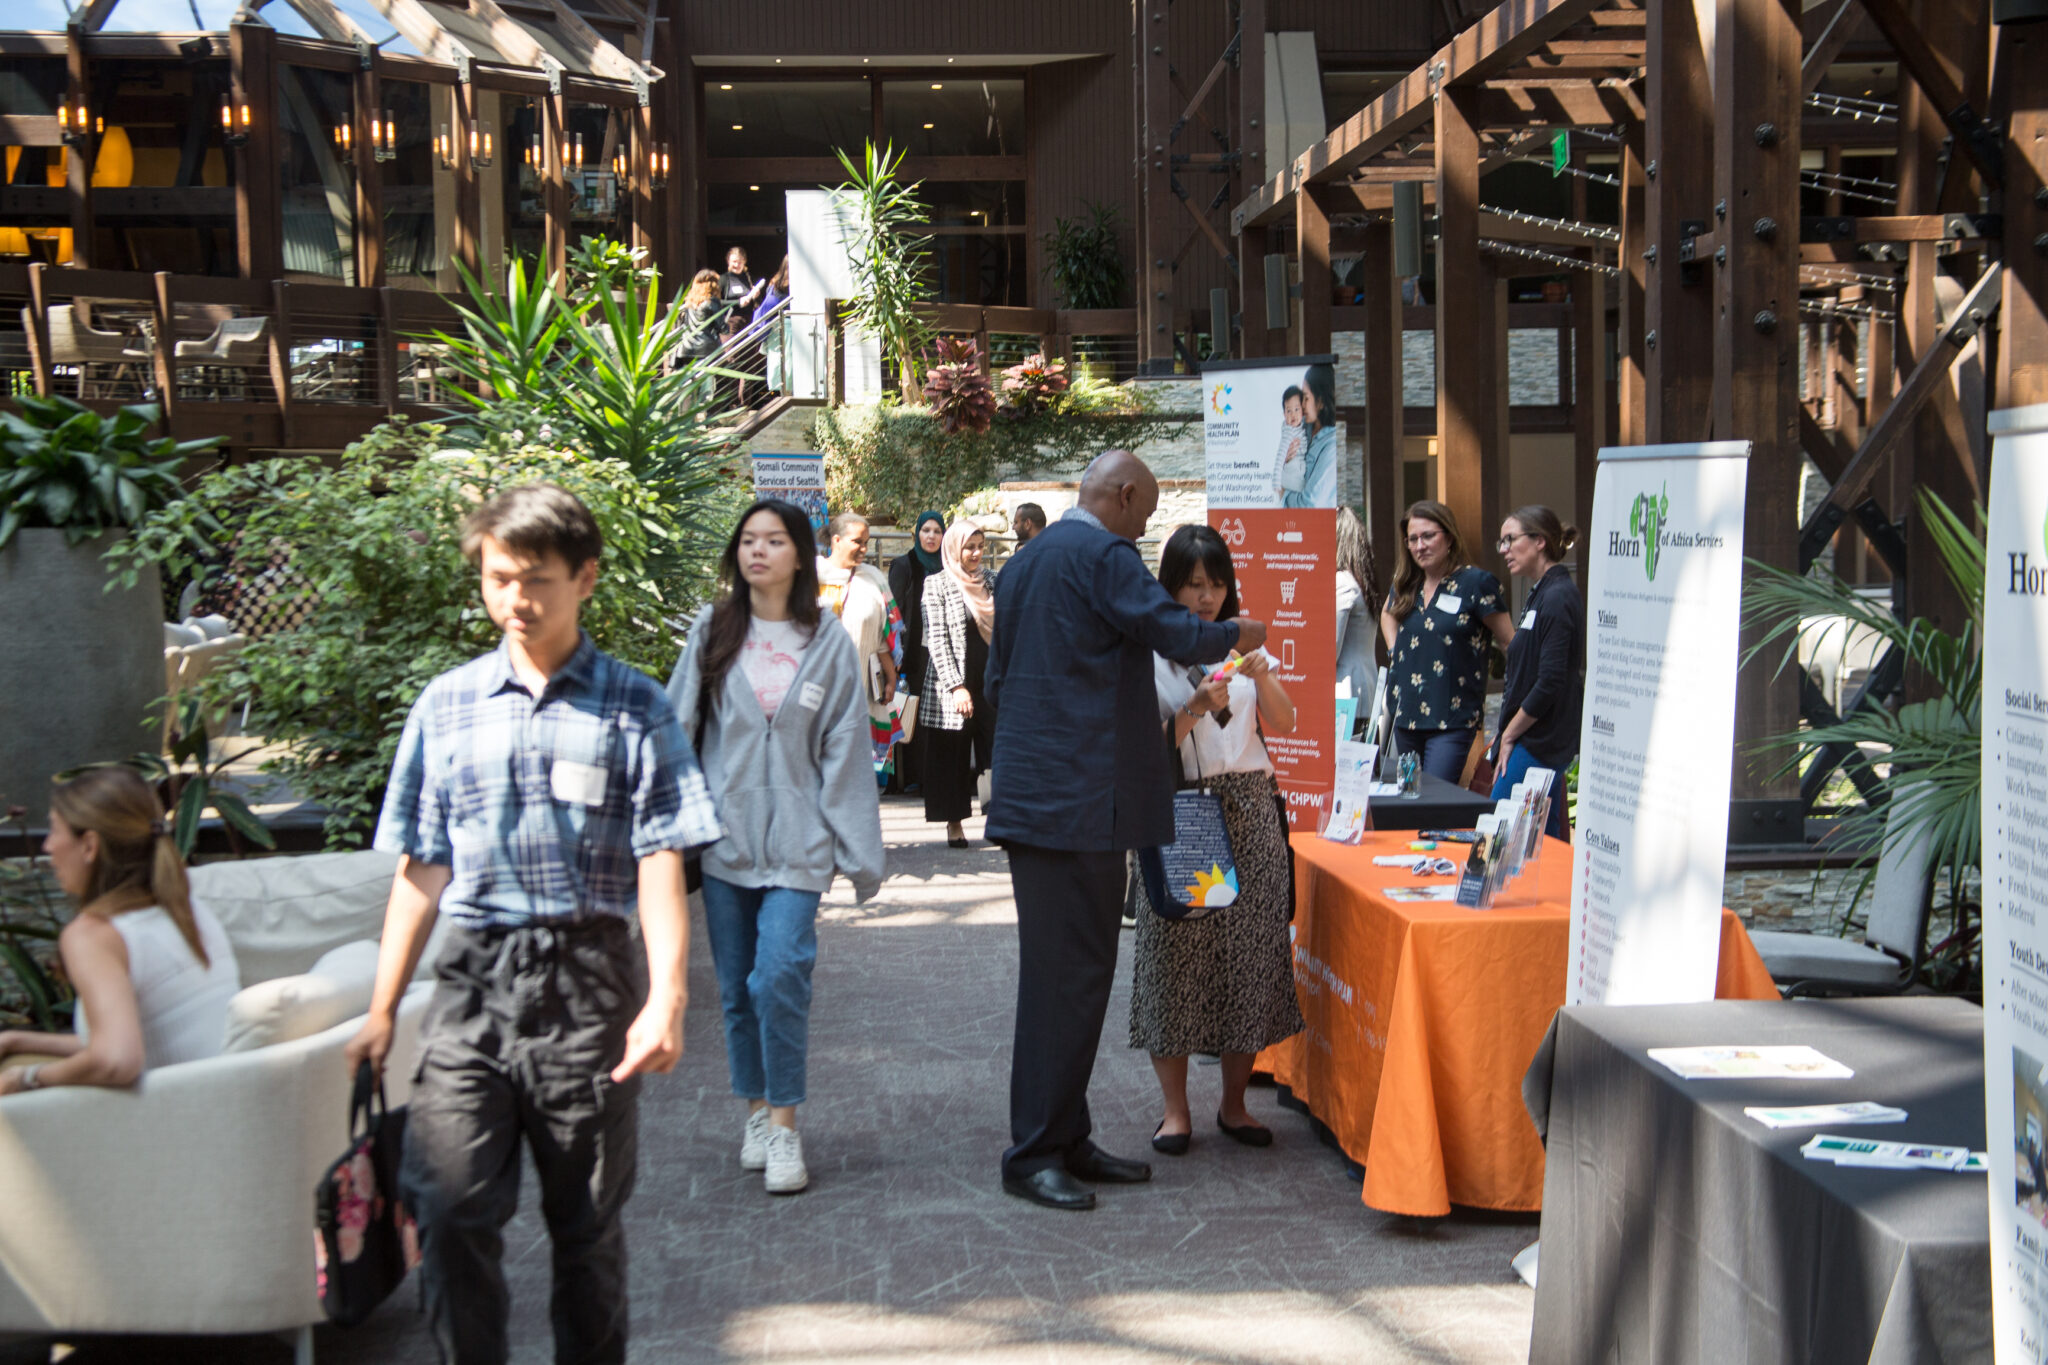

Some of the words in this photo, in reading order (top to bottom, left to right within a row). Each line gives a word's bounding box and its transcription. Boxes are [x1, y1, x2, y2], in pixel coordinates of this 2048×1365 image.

[756, 461, 780, 471] Somali
[781, 461, 819, 474] Community
[1233, 460, 1260, 469] benefits
[758, 475, 787, 486] Services
[788, 475, 795, 486] of
[796, 476, 820, 486] Seattle
[1216, 472, 1253, 482] Community
[1253, 472, 1272, 480] Health
[1221, 495, 1242, 503] Health
[1243, 495, 1274, 503] (Medicaid)
[1225, 484, 1263, 493] Washington
[1608, 530, 1640, 557] Horn
[1661, 531, 1670, 546] of
[1671, 532, 1694, 548] Africa
[1694, 532, 1724, 549] Services
[1598, 609, 1618, 625] Vision
[2005, 687, 2031, 711] Social
[1592, 714, 1615, 733] Mission
[2006, 726, 2043, 755] Citizenship
[2006, 751, 2047, 777] Immigration
[2006, 776, 2025, 798] Work
[2006, 801, 2021, 820] Job
[1585, 828, 1600, 846] Core
[1601, 833, 1620, 853] Values
[2007, 825, 2036, 855] Housing
[2008, 875, 2028, 898] Fresh
[2010, 939, 2034, 967] Youth
[2011, 977, 2027, 1000] After
[2011, 1002, 2031, 1029] Youth
